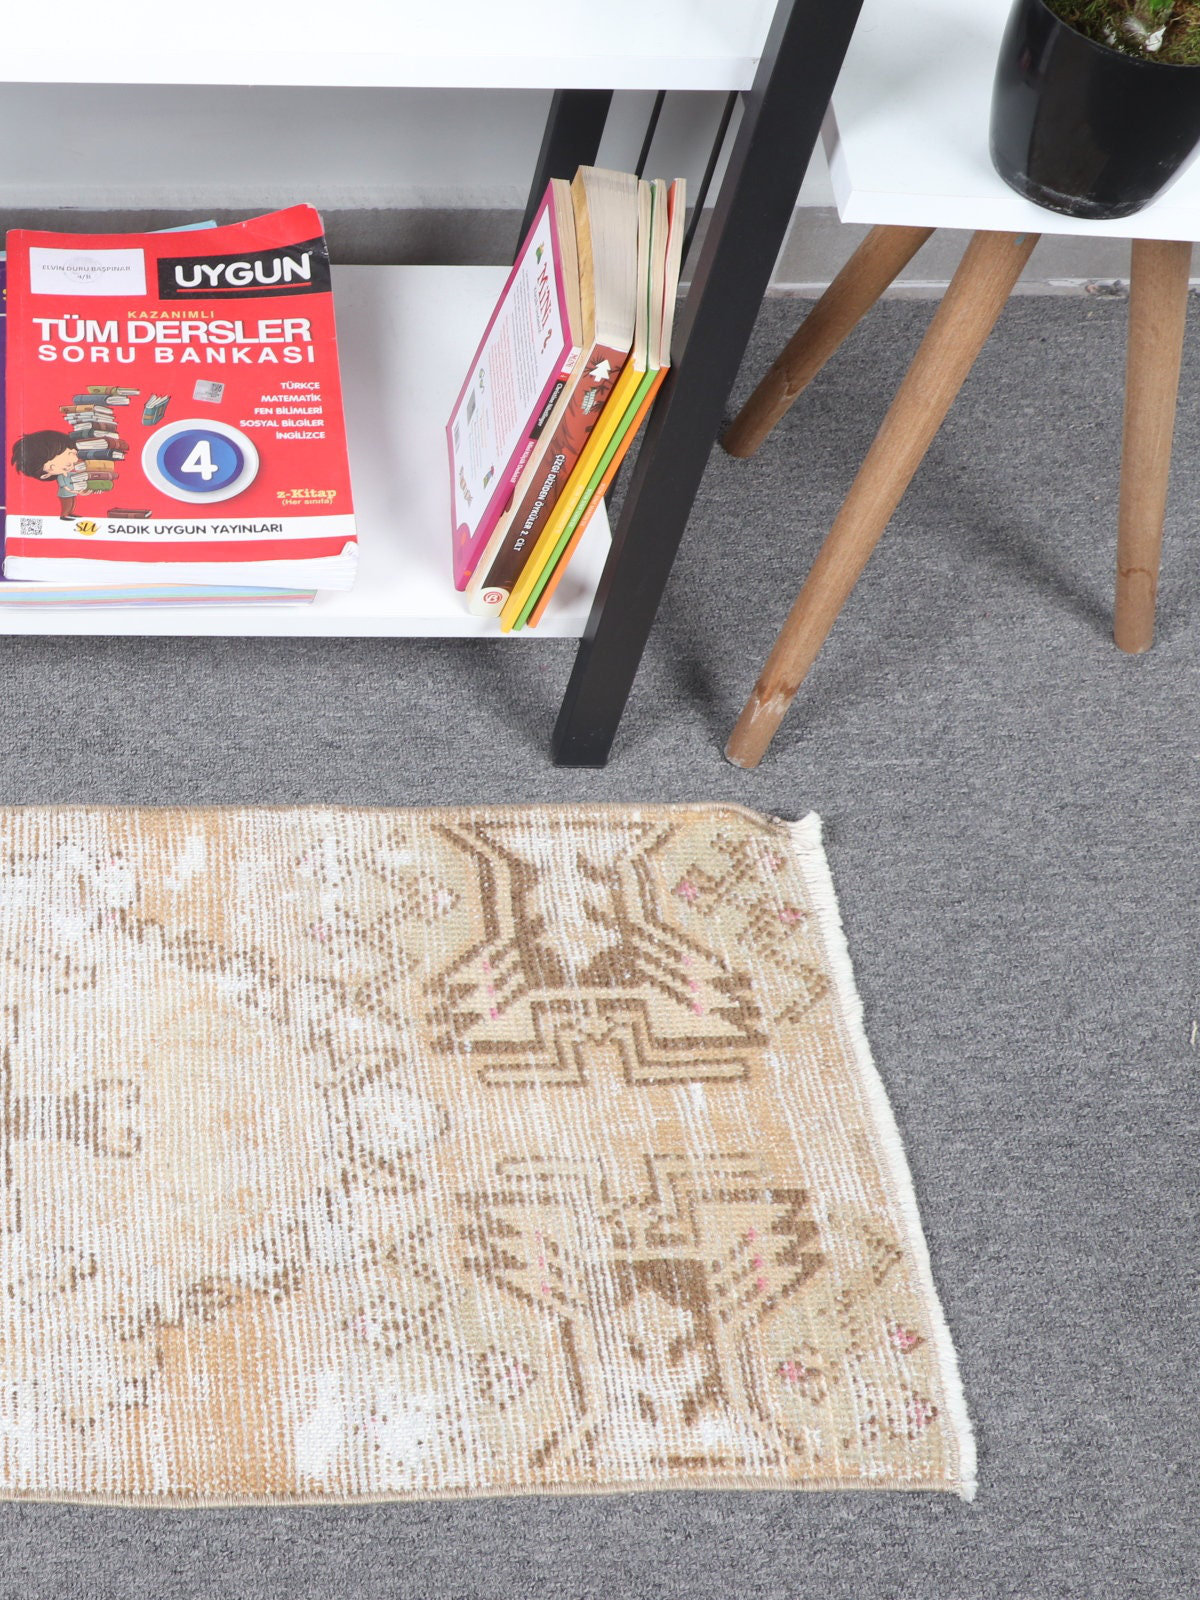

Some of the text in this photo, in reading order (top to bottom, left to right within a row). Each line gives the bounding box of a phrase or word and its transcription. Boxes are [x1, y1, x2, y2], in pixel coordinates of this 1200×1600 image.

[174, 253, 311, 288] UYGUN
[127, 310, 215, 319] KAZANIMLI
[32, 314, 312, 344] TÜM DERSLER
[37, 344, 315, 364] SORU BANKASI
[280, 381, 320, 390] TÜRKÇE
[261, 393, 322, 402] MATEMATİK
[254, 406, 323, 415] FEN BİLİMLERİ
[240, 418, 325, 427] SOSYAL BİLGİLER
[276, 430, 325, 440] İNGİLİZCE
[180, 440, 219, 481] 4
[550, 454, 565, 474] ÇİZGİ
[276, 488, 337, 499] z-Kitap
[538, 473, 557, 501] DİZİDEN
[524, 500, 545, 531] ÖYKÜLER
[107, 523, 283, 535] SADIK UYGUN YAYINLARI
[513, 538, 526, 552] CİLT
